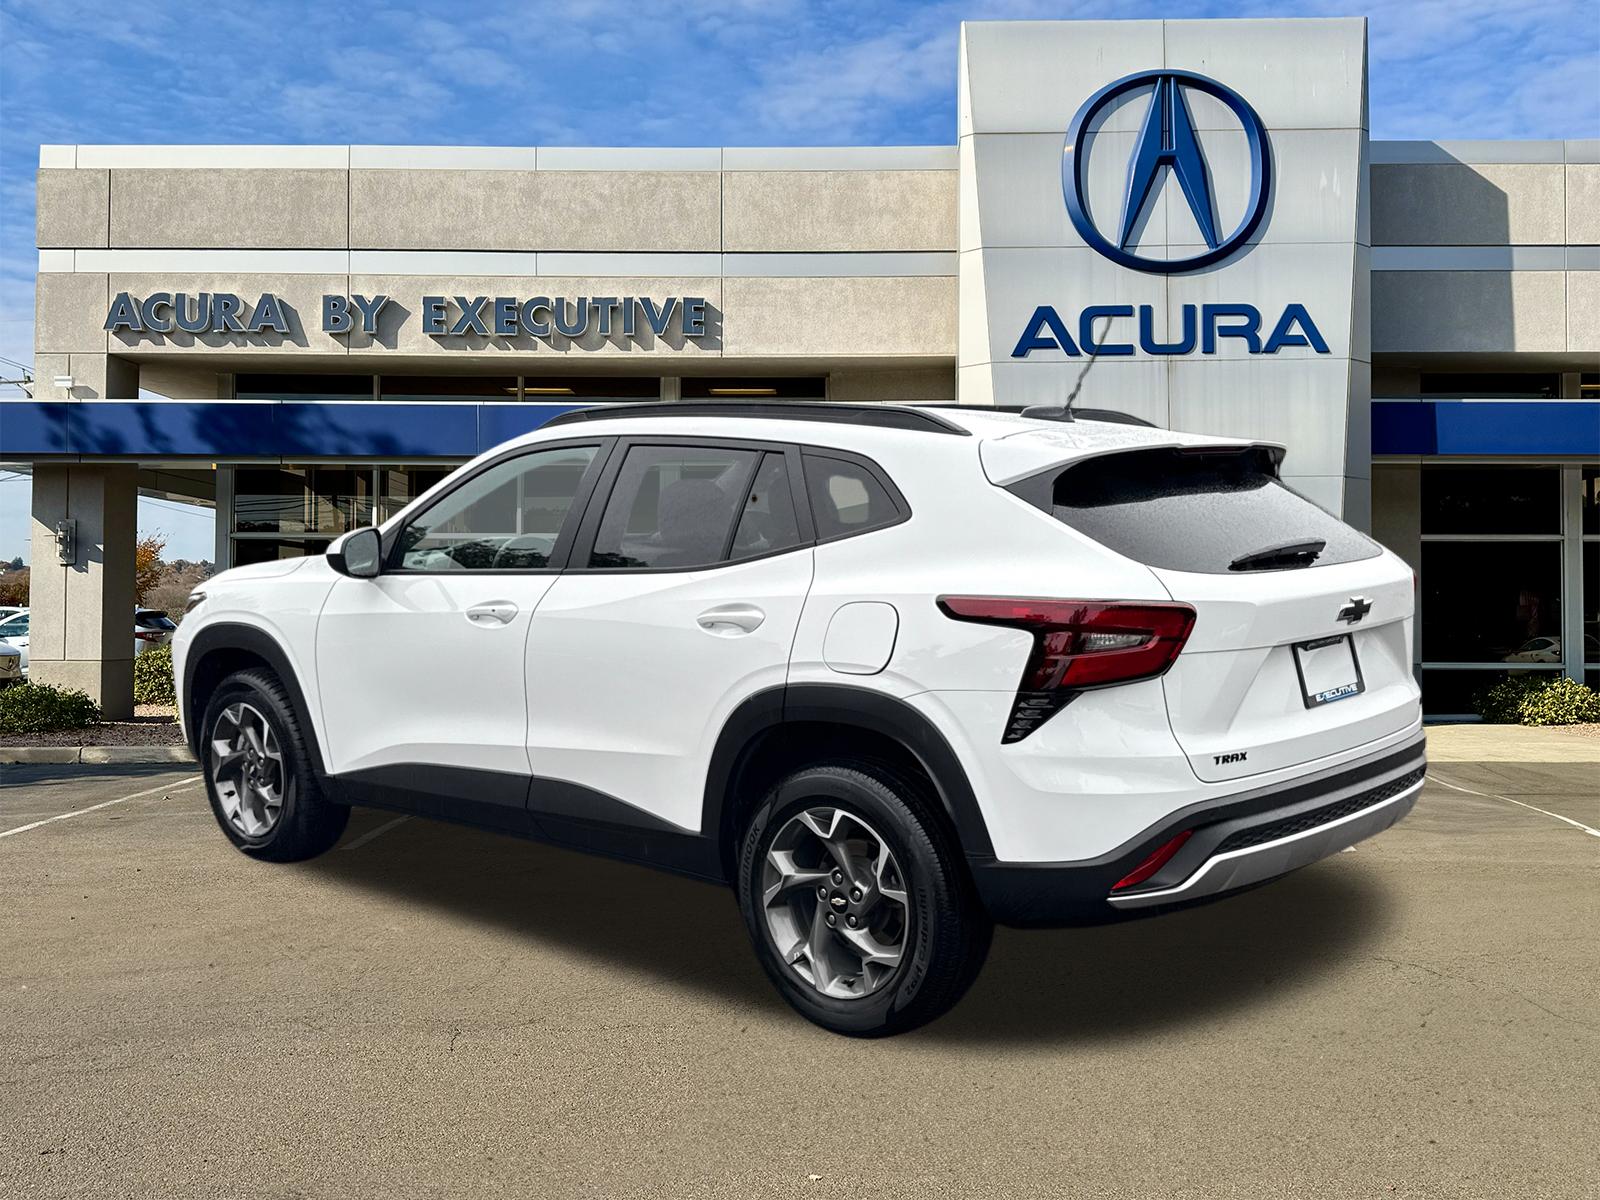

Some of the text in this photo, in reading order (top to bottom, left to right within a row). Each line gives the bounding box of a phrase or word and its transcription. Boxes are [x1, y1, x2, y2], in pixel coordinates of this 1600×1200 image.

[104, 292, 708, 338] ACURA BY EXECUTIVE
[1011, 304, 1332, 357] ACURA
[1315, 683, 1358, 702] EXECUTIVE
[1213, 752, 1248, 766] TRAX
